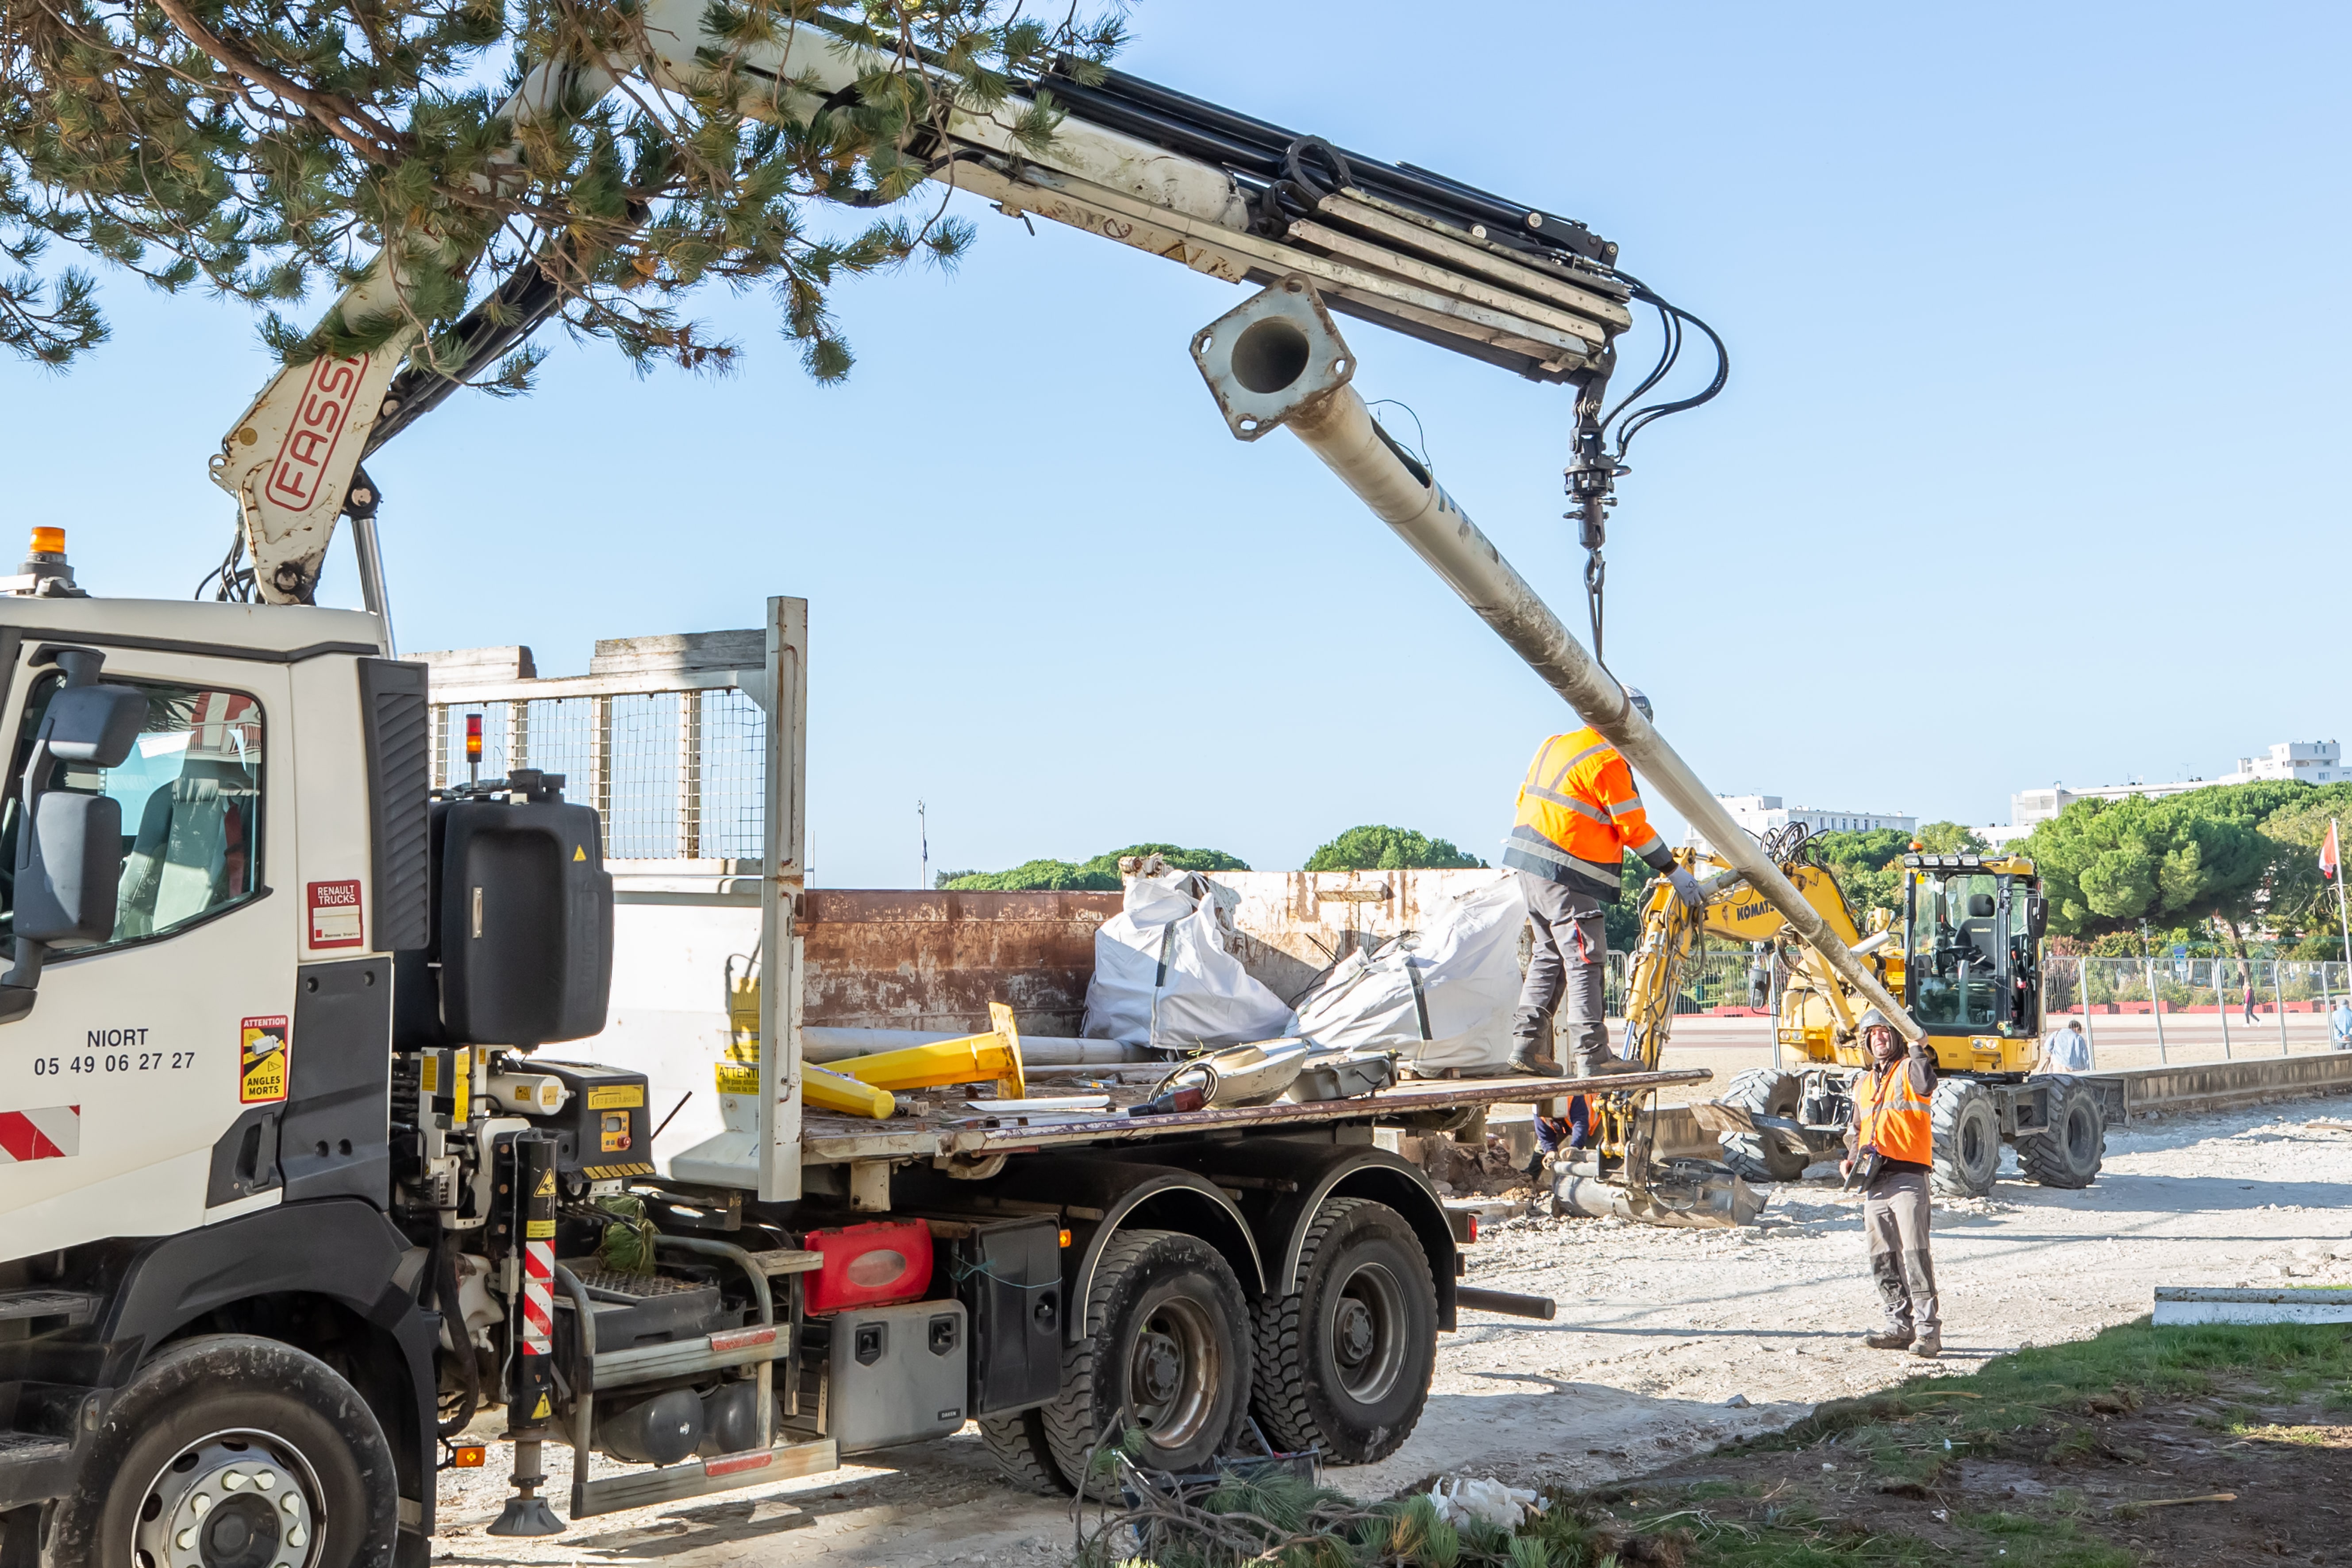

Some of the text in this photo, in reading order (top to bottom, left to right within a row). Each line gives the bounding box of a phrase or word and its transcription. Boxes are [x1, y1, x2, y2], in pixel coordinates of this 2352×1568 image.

[318, 885, 354, 896] RENAULT
[318, 894, 355, 905] TRUCKS
[244, 1018, 286, 1027] ATTENTION
[87, 1029, 149, 1047] NIORT
[34, 1052, 195, 1075] 05 49 06 27 27
[247, 1076, 280, 1086] ANGLES
[249, 1086, 278, 1096] MORTS
